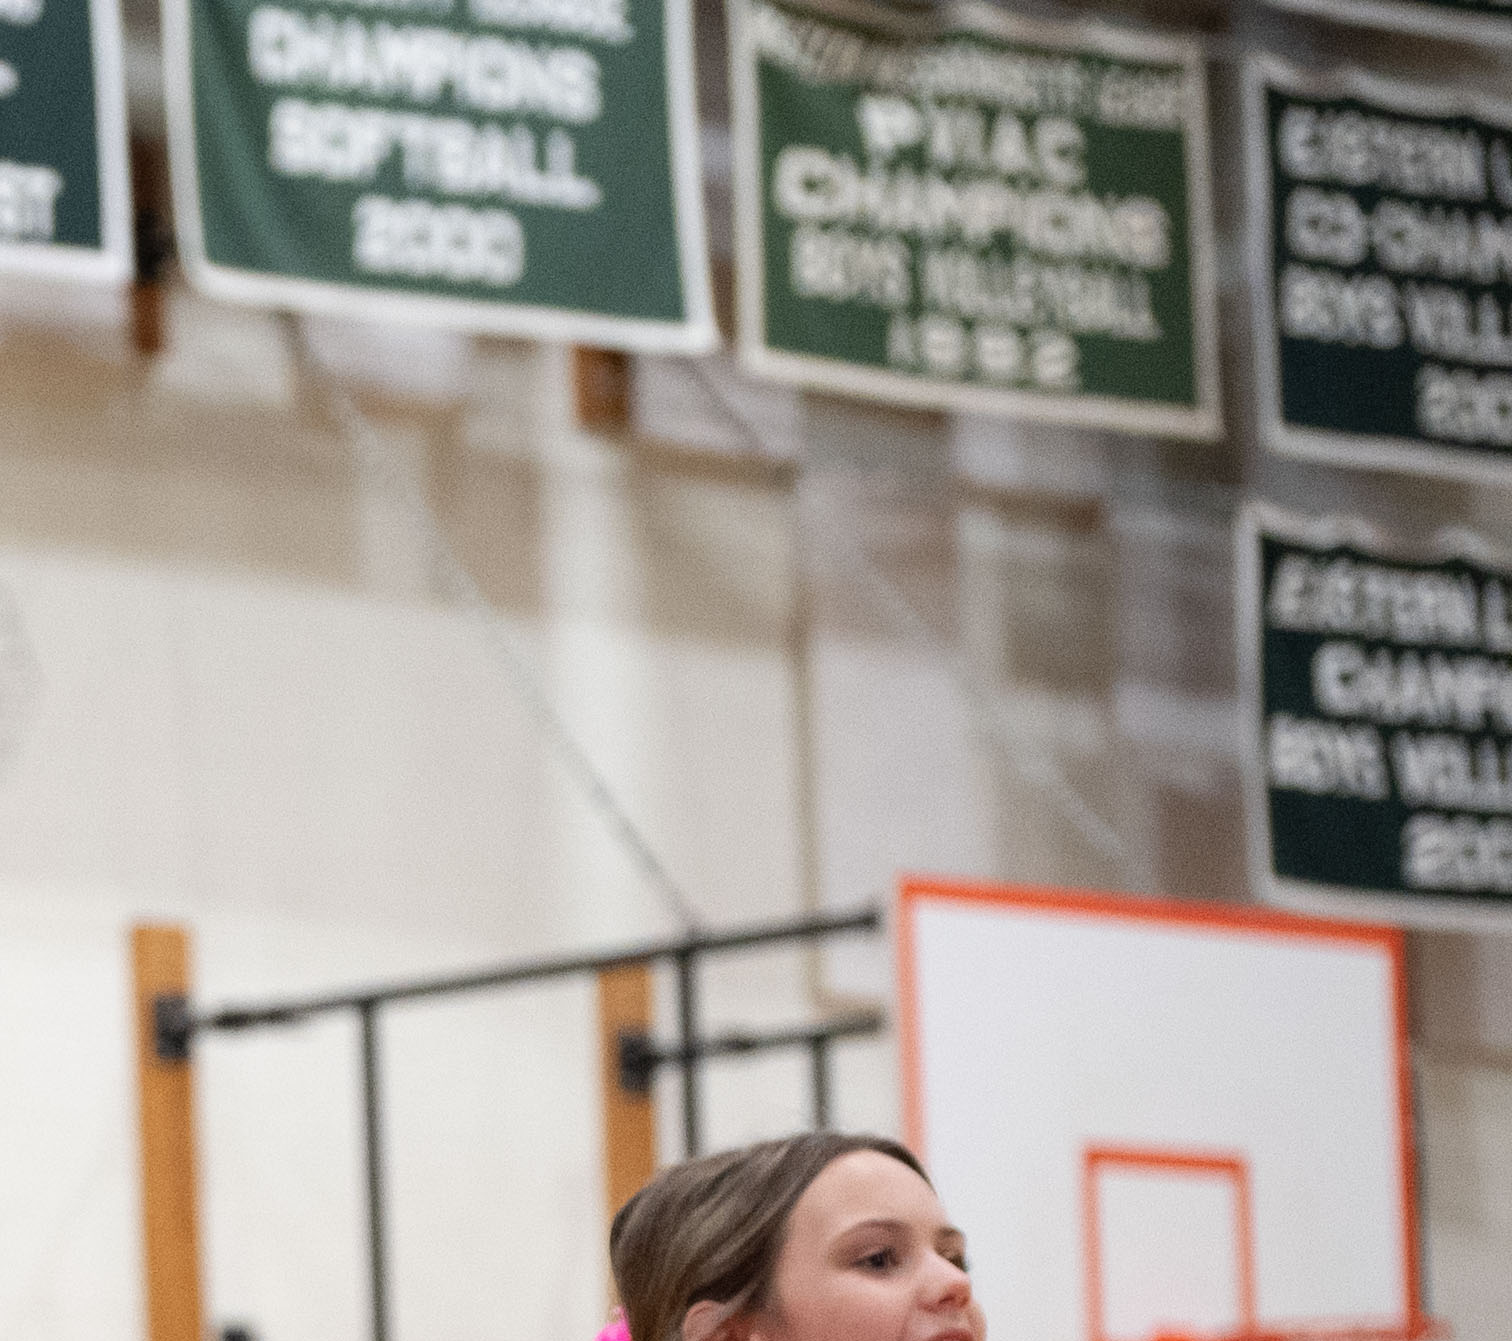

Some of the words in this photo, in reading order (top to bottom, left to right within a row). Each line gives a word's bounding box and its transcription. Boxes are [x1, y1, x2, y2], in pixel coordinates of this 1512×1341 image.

[247, 4, 603, 126] CHAMPIONS
[268, 96, 603, 212] SOFTBALL
[771, 144, 1170, 268] CHAMPIONS
